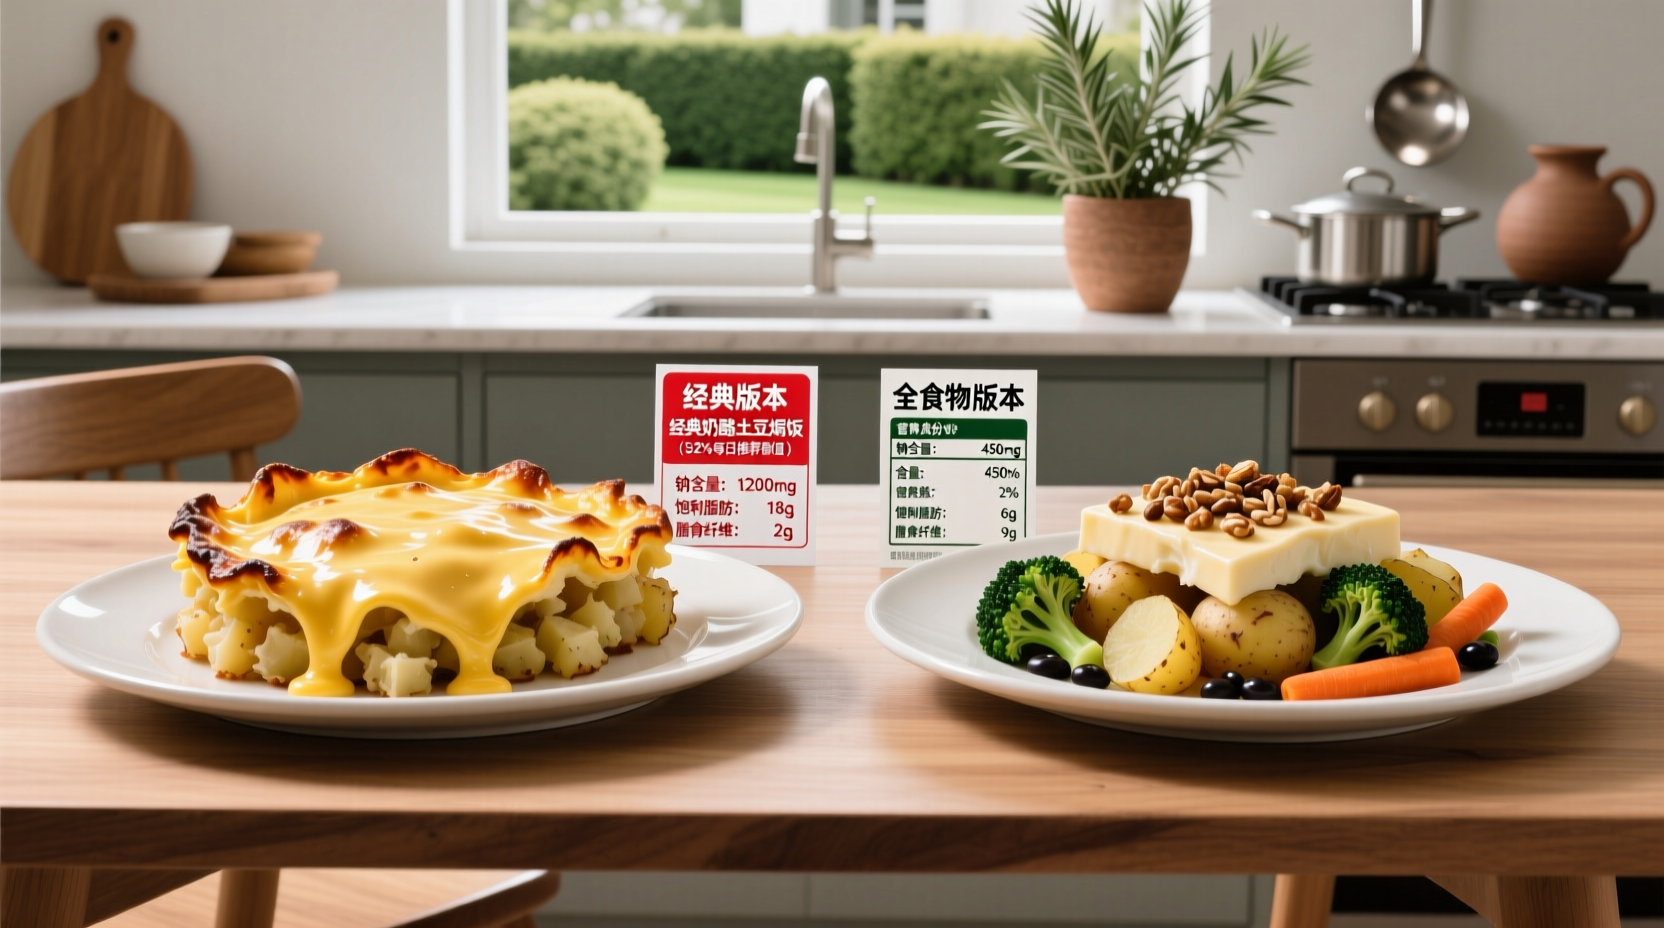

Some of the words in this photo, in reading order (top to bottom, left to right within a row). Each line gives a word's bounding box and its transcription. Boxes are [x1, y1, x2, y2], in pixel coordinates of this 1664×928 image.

[683, 383, 787, 411] 经典版本
[893, 382, 1024, 411] 全食物版本
[738, 477, 796, 496] 1200mg
[768, 501, 794, 518] 18g
[1001, 508, 1016, 522] 6g
[773, 523, 793, 541] 2g
[1002, 527, 1016, 541] 9g
